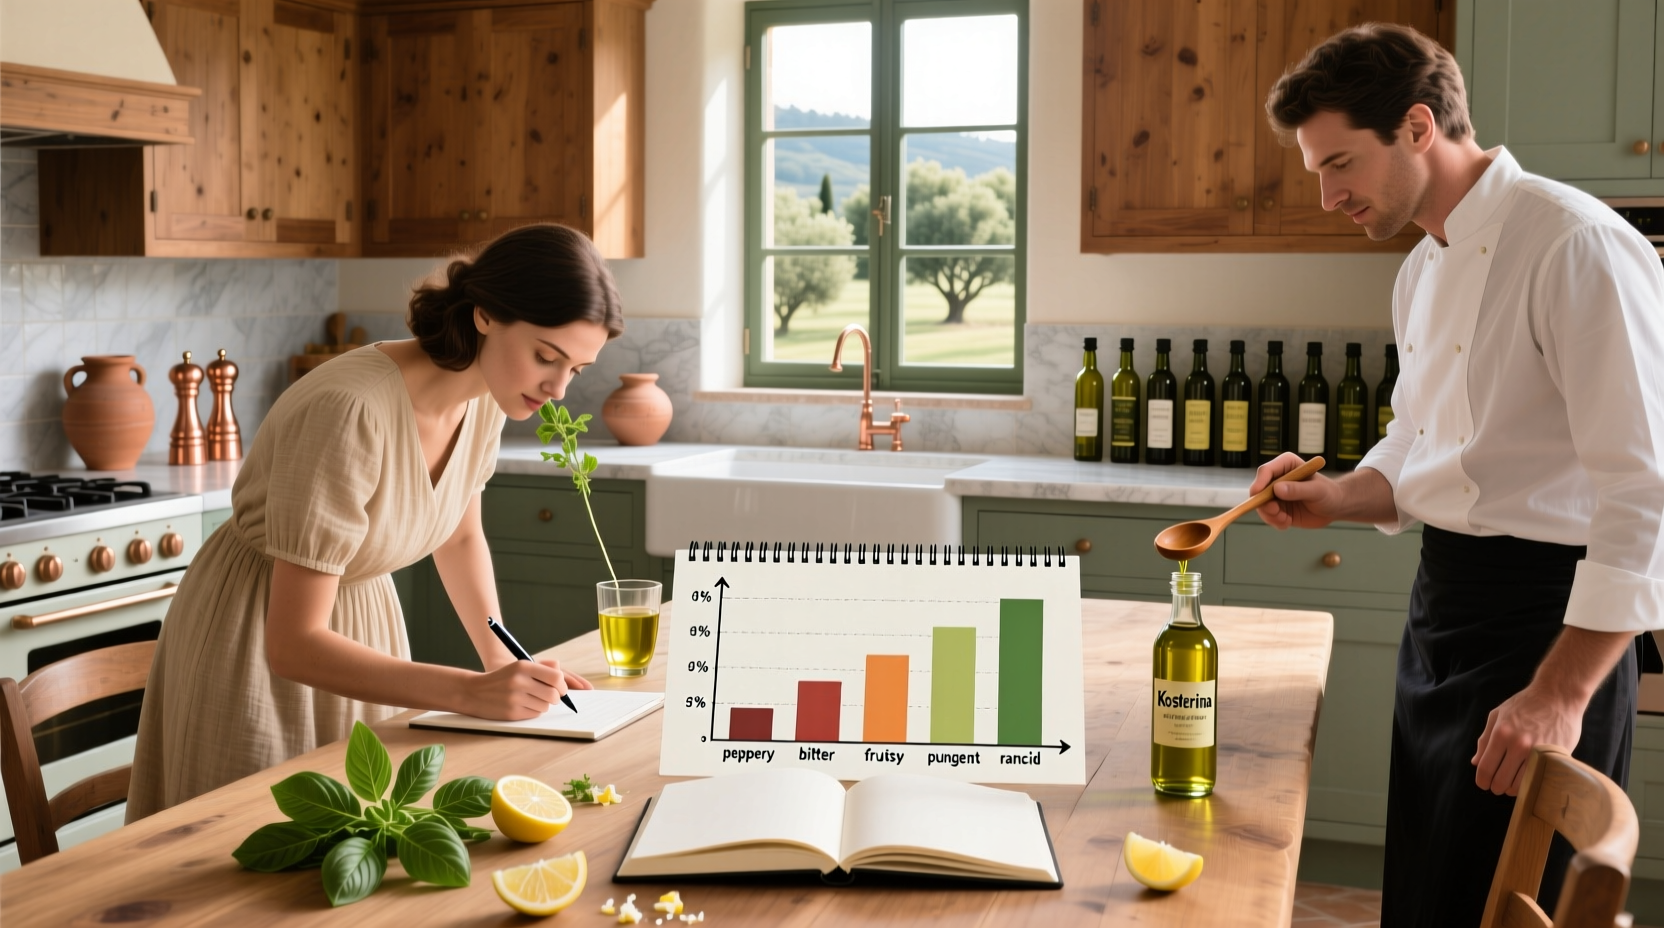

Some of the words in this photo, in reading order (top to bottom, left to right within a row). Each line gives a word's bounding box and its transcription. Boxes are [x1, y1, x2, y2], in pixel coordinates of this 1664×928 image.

[1157, 690, 1212, 709] Kosterina
[722, 749, 775, 764] peppery
[927, 751, 981, 768] pungent
[1000, 750, 1041, 766] rancid
